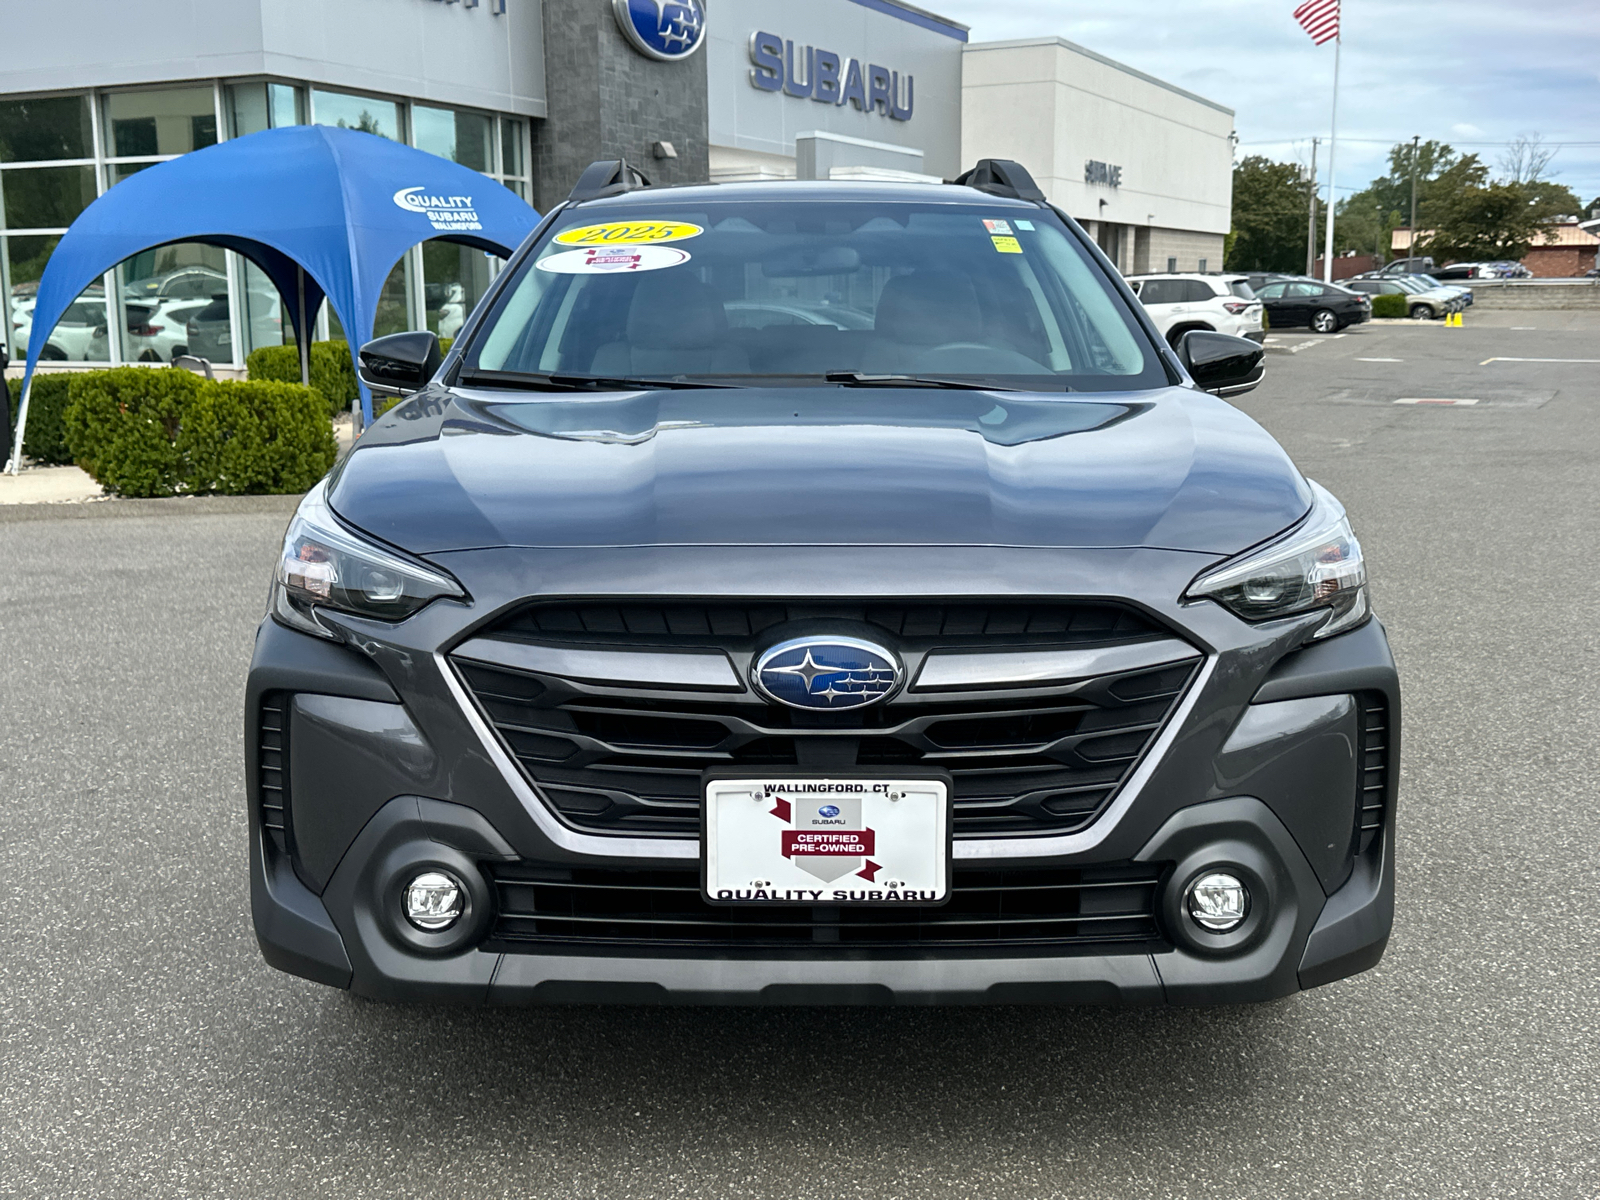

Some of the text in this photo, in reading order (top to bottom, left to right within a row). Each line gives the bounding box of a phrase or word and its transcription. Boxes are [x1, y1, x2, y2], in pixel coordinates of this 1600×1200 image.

[750, 31, 914, 122] SUBARU
[406, 194, 472, 207] QUALITY
[426, 211, 479, 222] SUBARU
[576, 225, 681, 243] 2025
[872, 783, 891, 793] CT
[796, 834, 860, 844] CERTIFIED
[790, 843, 866, 853] PRE-OWNED
[716, 889, 825, 901] QUALITY
[832, 889, 937, 901] SUBARU
